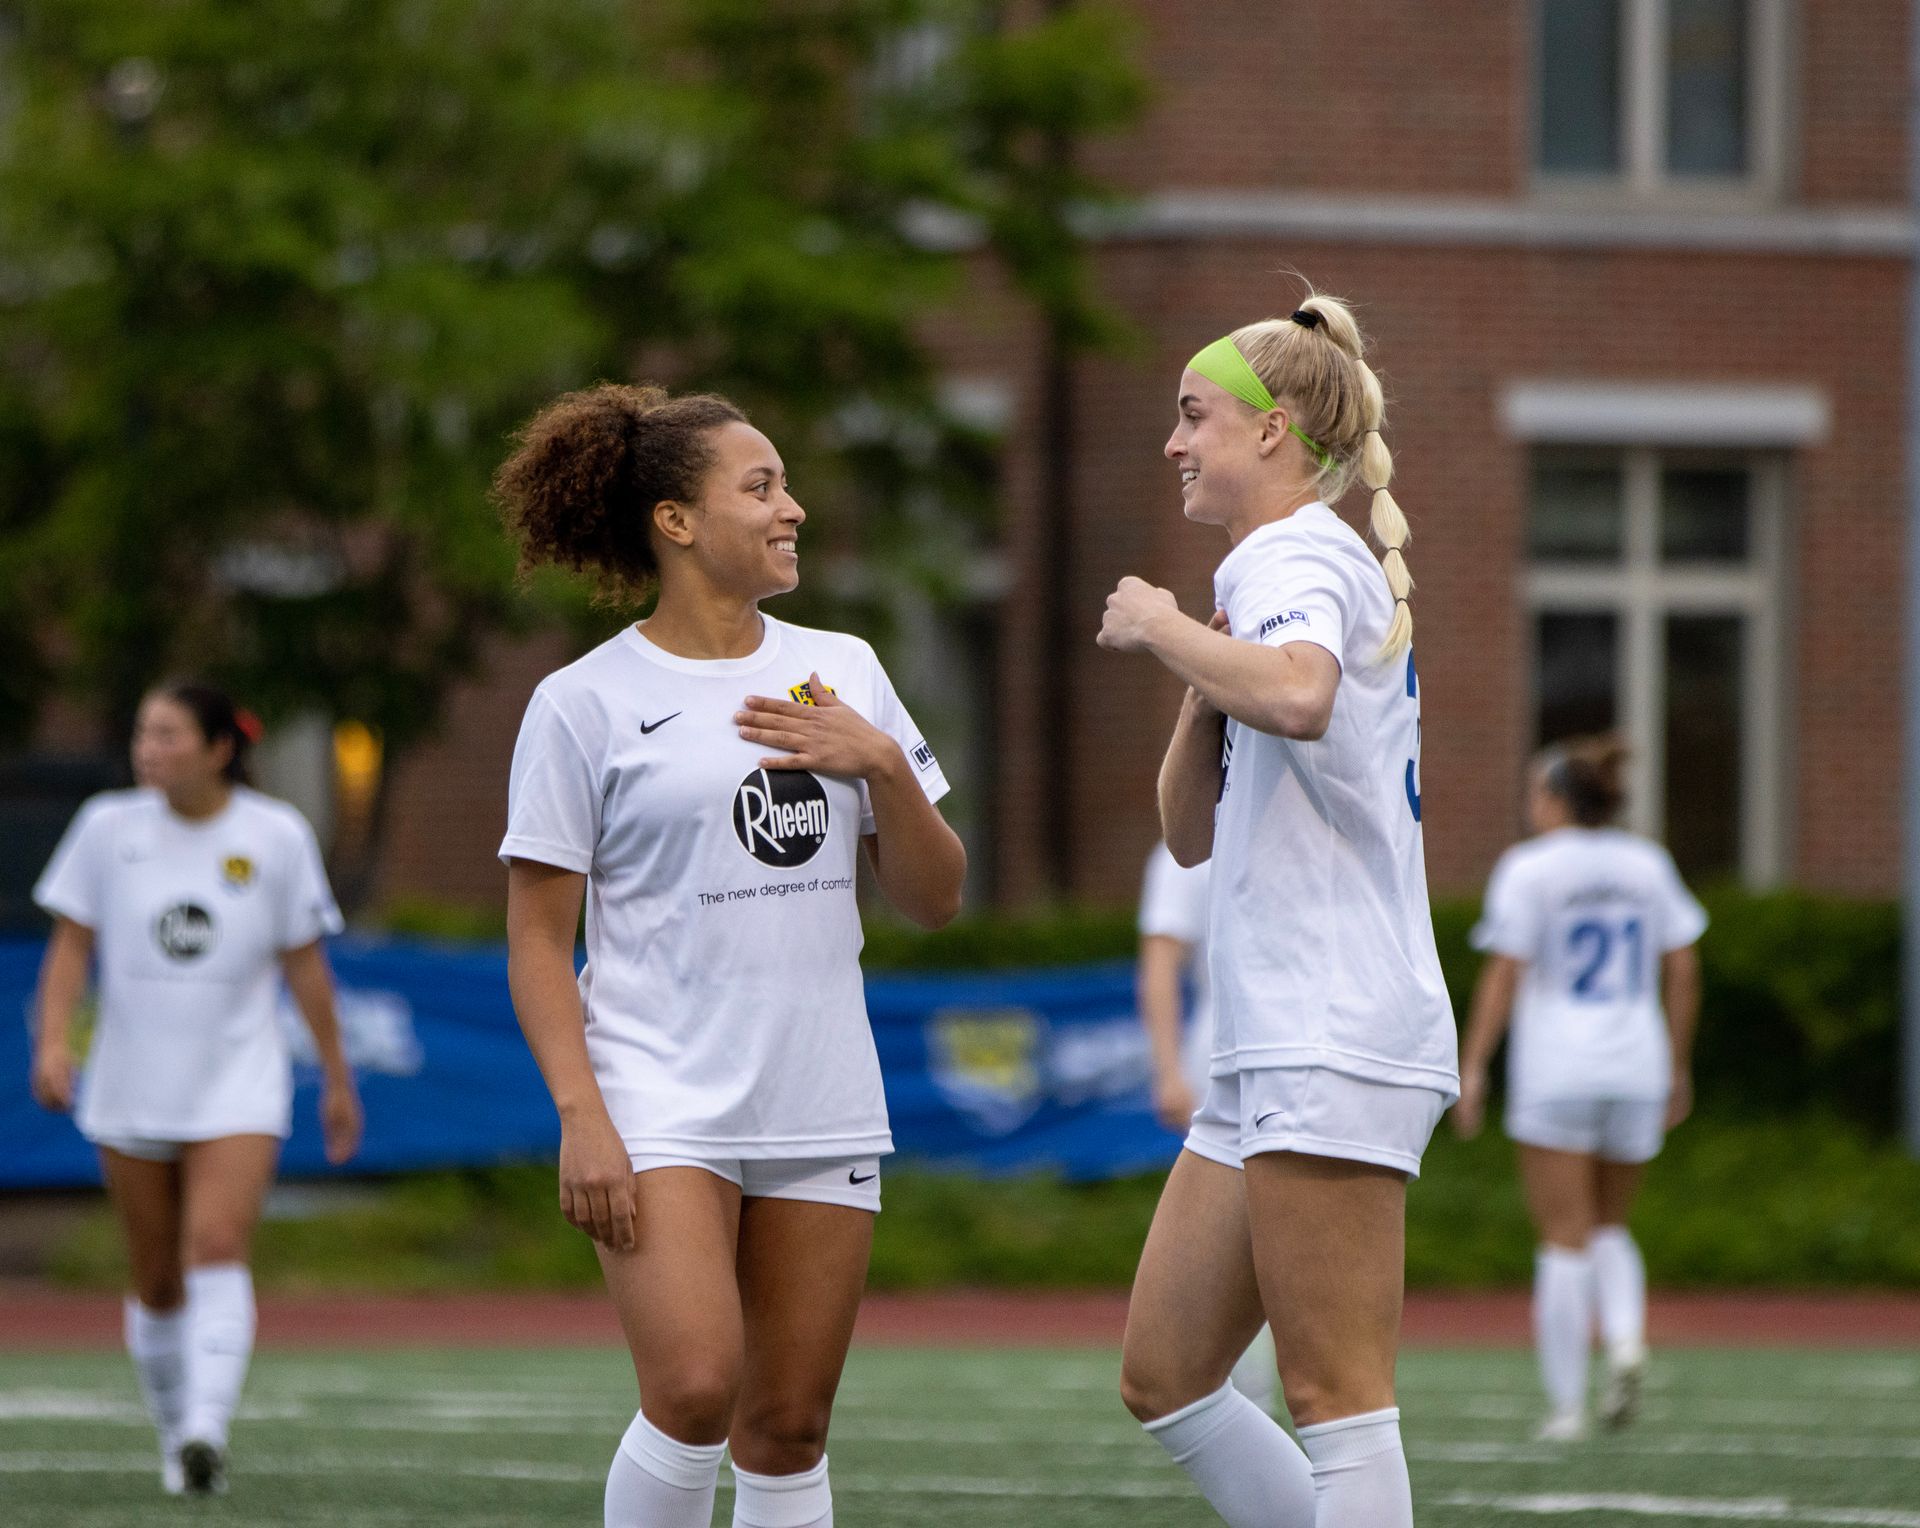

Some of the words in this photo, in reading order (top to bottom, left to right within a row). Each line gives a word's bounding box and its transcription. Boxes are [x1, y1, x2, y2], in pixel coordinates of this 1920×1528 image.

[741, 768, 827, 853] Rheem
[698, 892, 725, 906] The
[728, 887, 757, 901] new
[760, 883, 805, 897] degree
[808, 878, 819, 891] of
[1567, 917, 1643, 1002] 21
